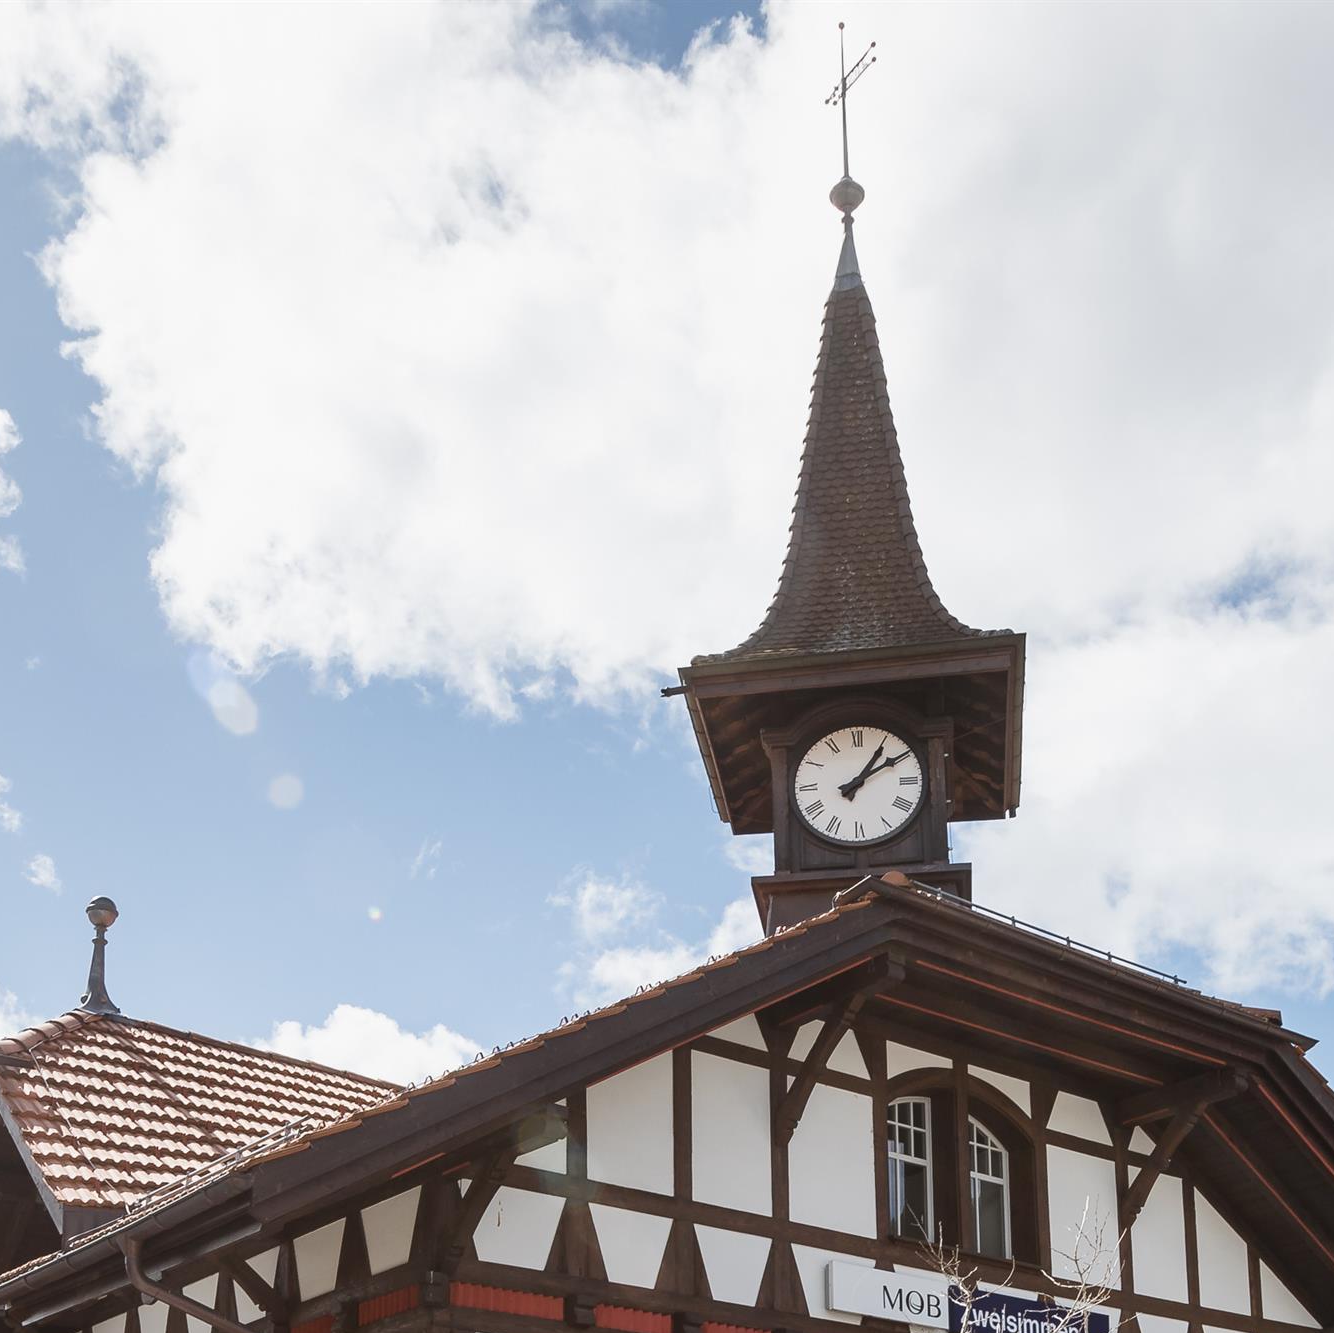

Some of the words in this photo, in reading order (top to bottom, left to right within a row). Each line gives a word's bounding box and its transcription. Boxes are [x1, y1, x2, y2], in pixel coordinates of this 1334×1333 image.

[851, 730, 863, 747] XII
[899, 777, 918, 785] III
[882, 1285, 942, 1318] MOB
